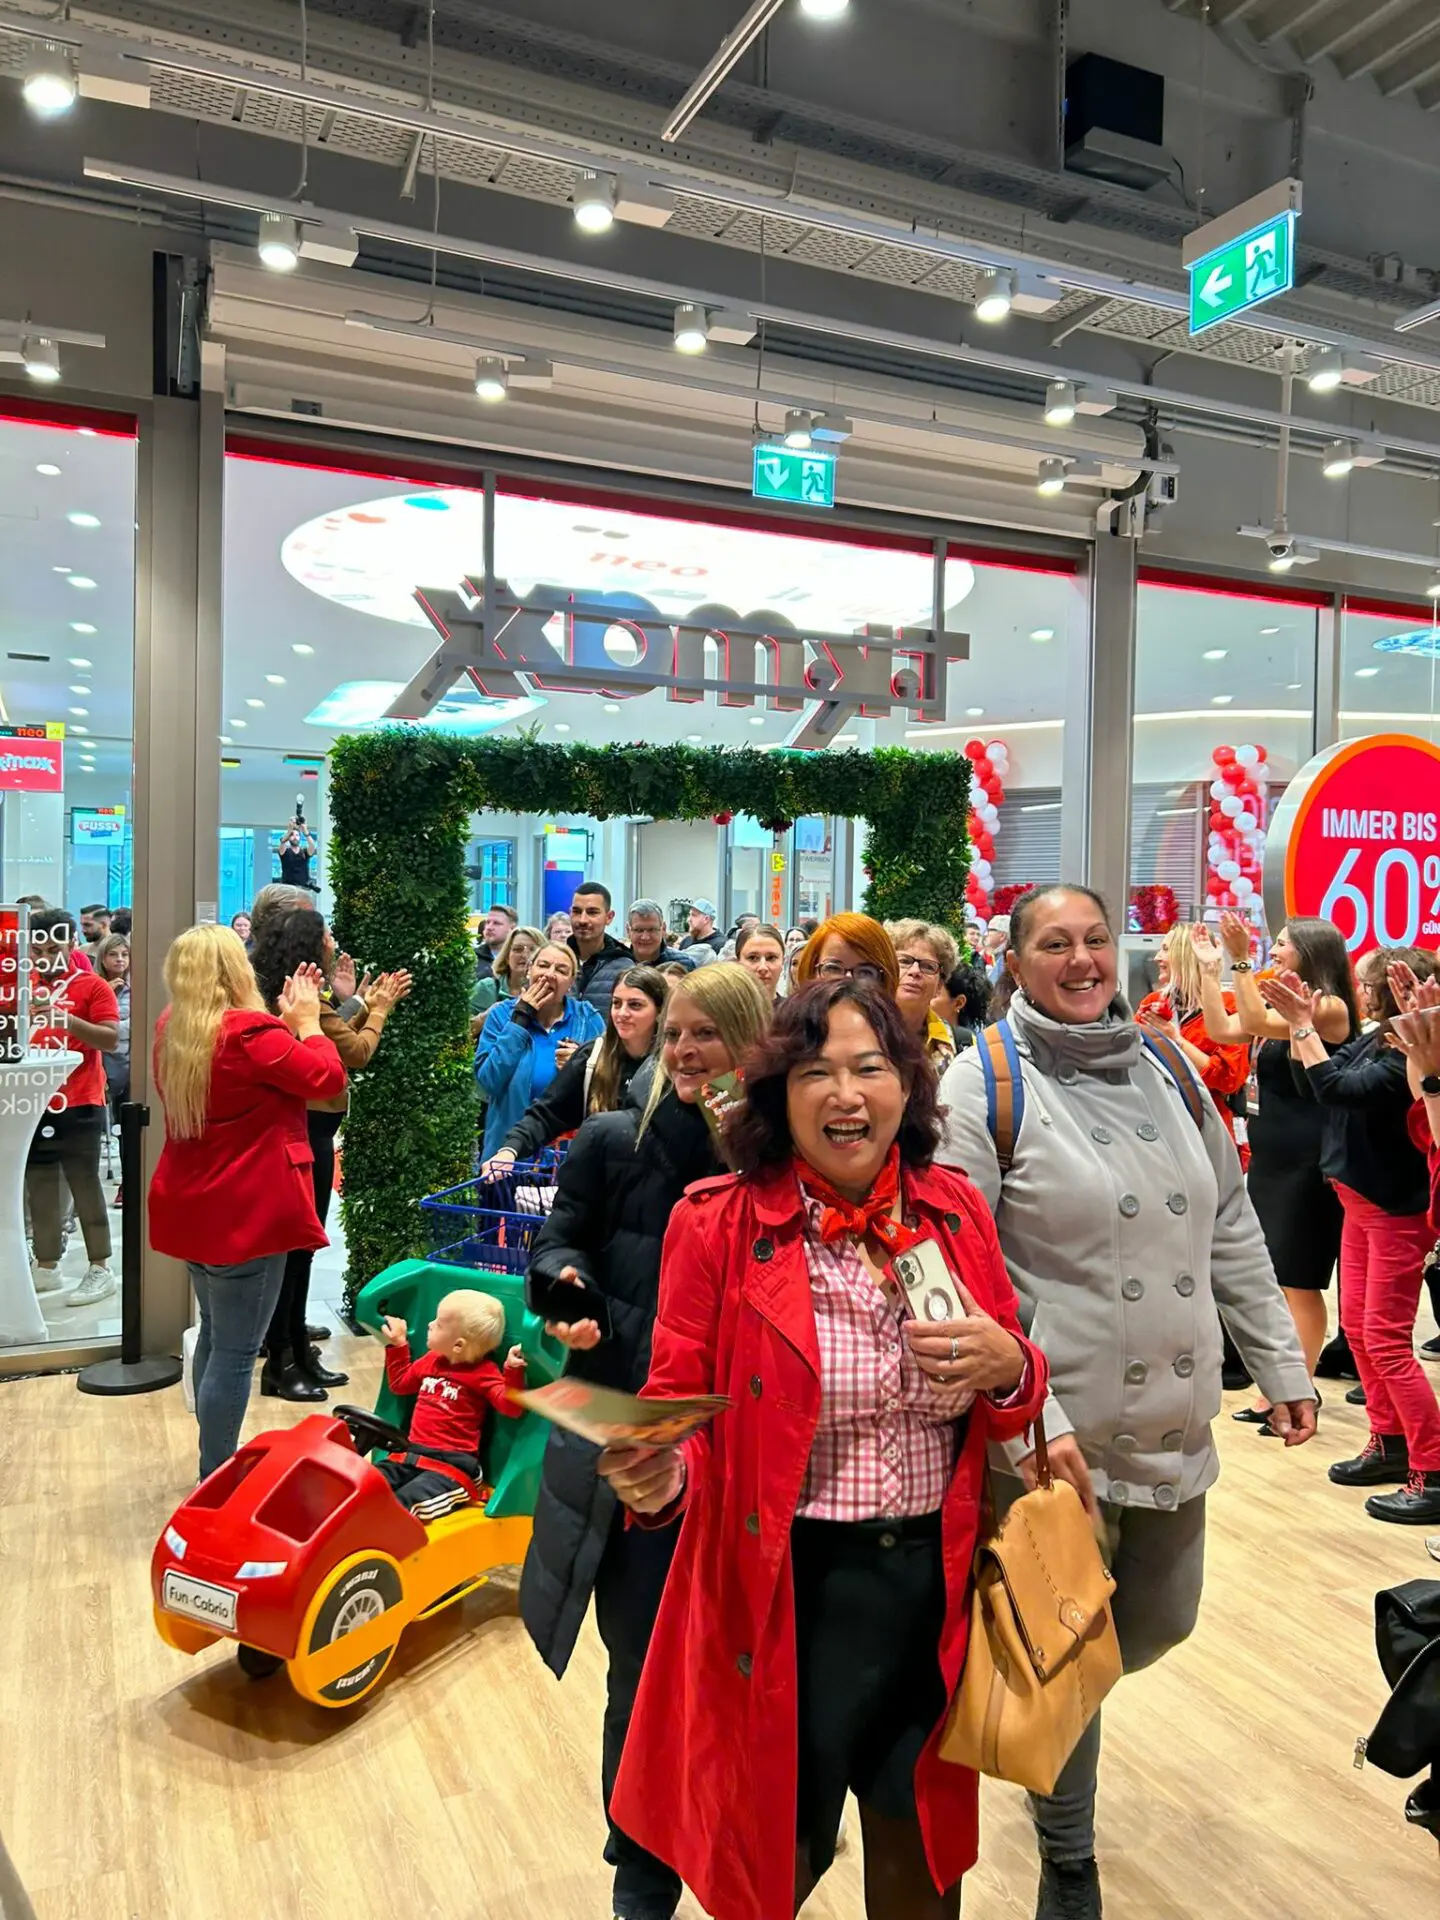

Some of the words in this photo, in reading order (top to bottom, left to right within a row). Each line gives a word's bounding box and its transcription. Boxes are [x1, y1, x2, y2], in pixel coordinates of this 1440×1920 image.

[16, 727, 45, 738] neo
[1322, 808, 1397, 840] IMMER
[1402, 812, 1437, 842] BIS
